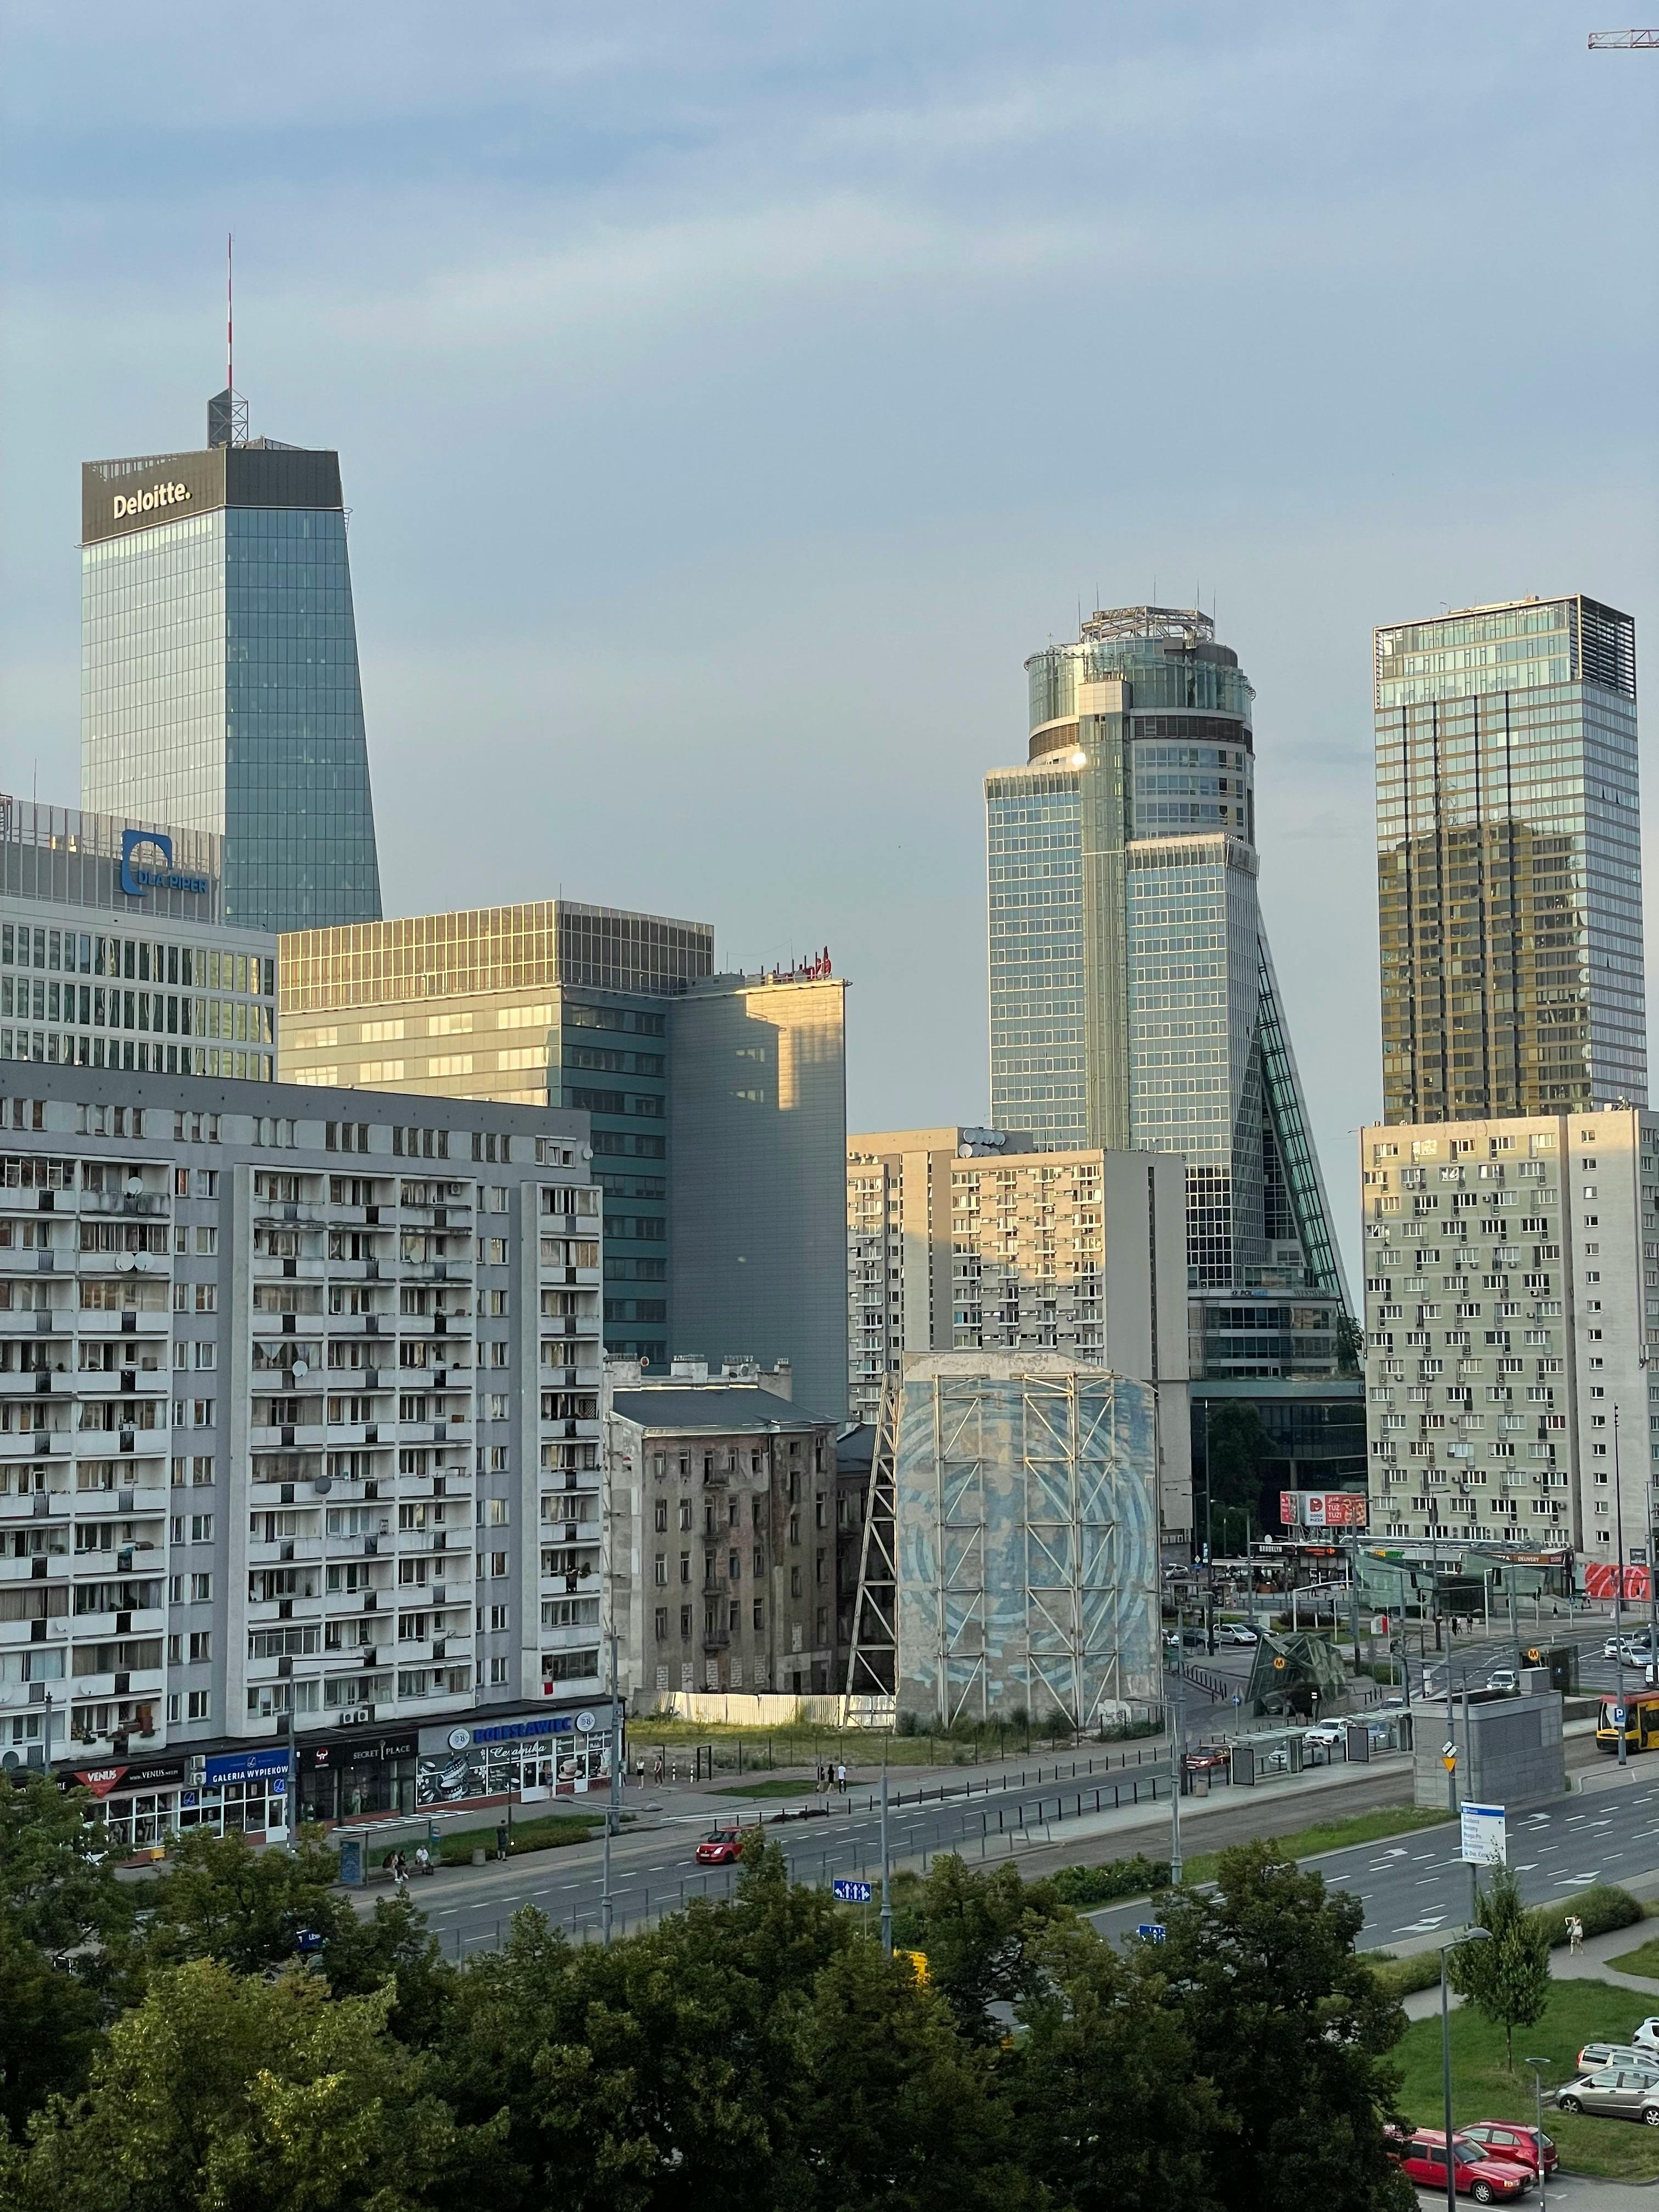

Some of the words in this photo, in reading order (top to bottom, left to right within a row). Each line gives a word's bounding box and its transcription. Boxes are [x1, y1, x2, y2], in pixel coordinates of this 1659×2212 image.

[114, 481, 191, 519] Deloitte.
[138, 871, 165, 887] DLA
[170, 876, 208, 894] PIPER
[1616, 1709, 1623, 1718] P
[353, 1750, 379, 1759] SECRET
[386, 1745, 410, 1755] PLACE
[88, 1770, 116, 1782] VENUS
[213, 1771, 245, 1782] GALERIA
[247, 1764, 289, 1778] WYPIEKÓW
